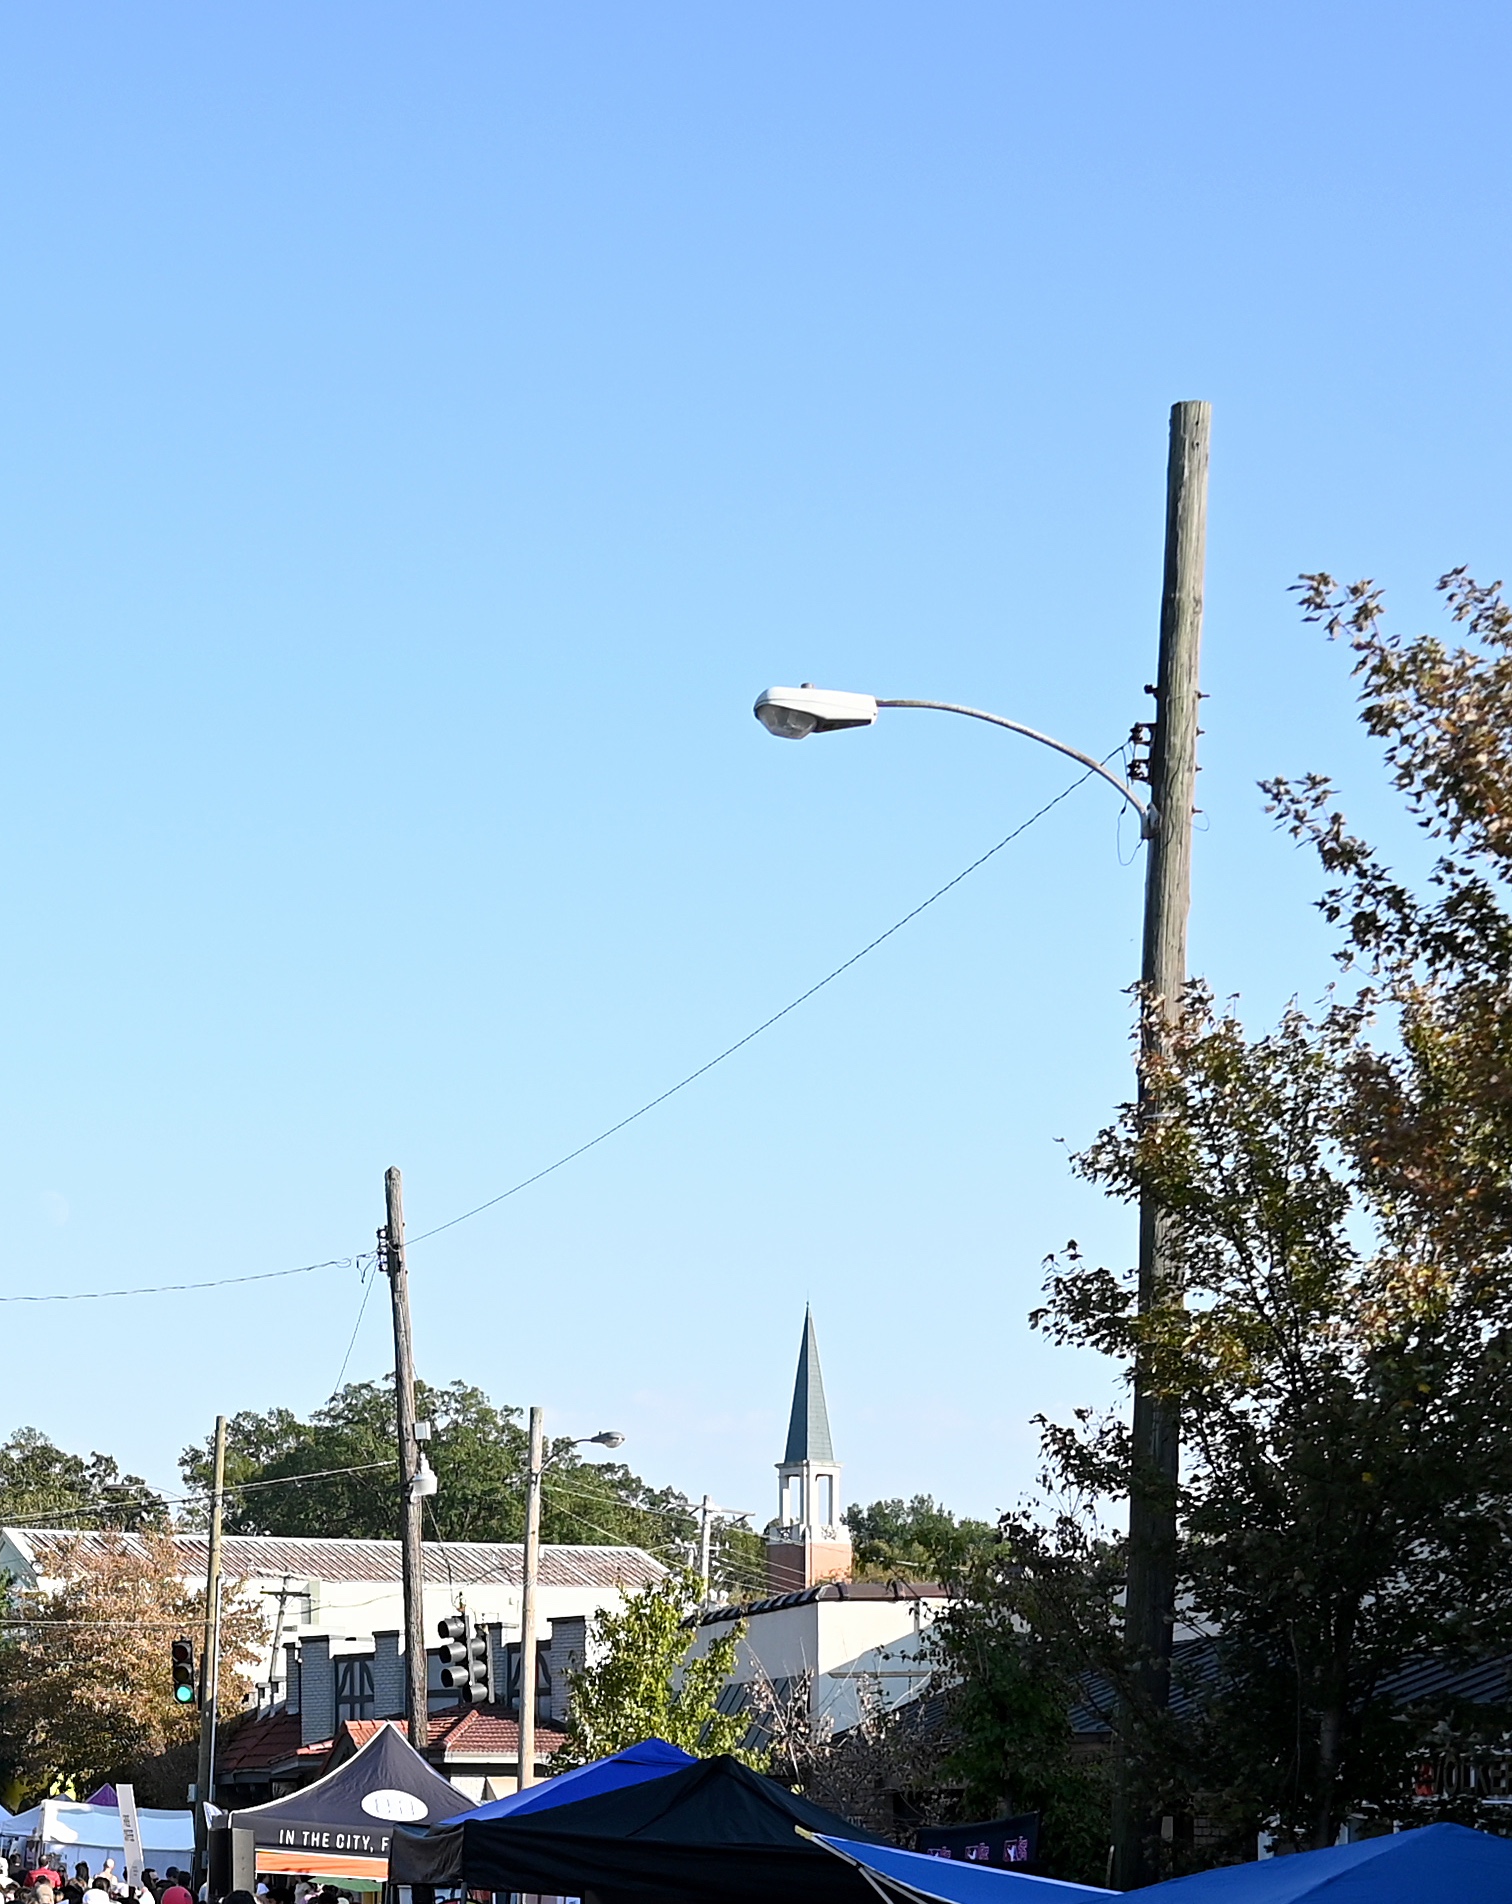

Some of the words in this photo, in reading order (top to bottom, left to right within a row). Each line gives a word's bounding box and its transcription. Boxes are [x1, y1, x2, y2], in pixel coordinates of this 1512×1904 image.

[279, 1829, 295, 1845] IN
[302, 1831, 330, 1848] THE
[335, 1833, 373, 1853] CITY,
